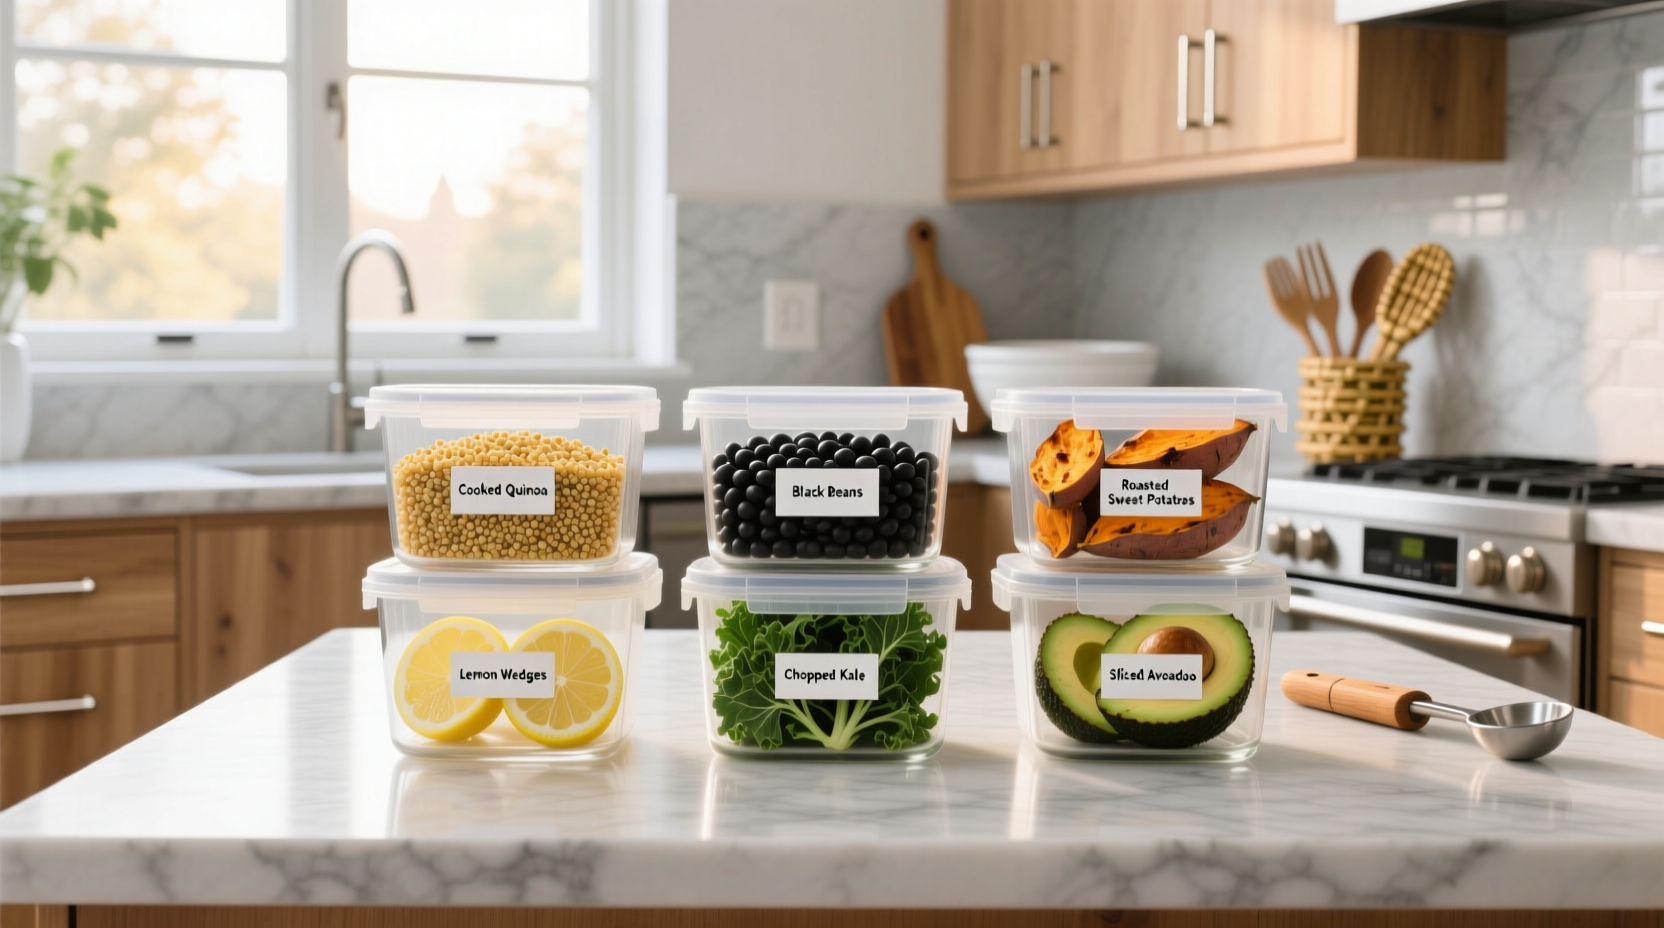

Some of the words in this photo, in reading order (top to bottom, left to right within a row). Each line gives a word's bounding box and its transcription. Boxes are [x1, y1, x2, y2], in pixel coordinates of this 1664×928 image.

[458, 482, 502, 496] Cooked
[505, 483, 548, 498] Quinoa
[792, 485, 825, 498] Black
[827, 485, 864, 498] Beans
[1121, 478, 1169, 491] Roasted
[1107, 493, 1143, 506] Sweet
[459, 668, 498, 681] Lemon
[500, 668, 548, 684] Wedges
[784, 667, 836, 685] Chopped
[840, 667, 866, 682] Kale
